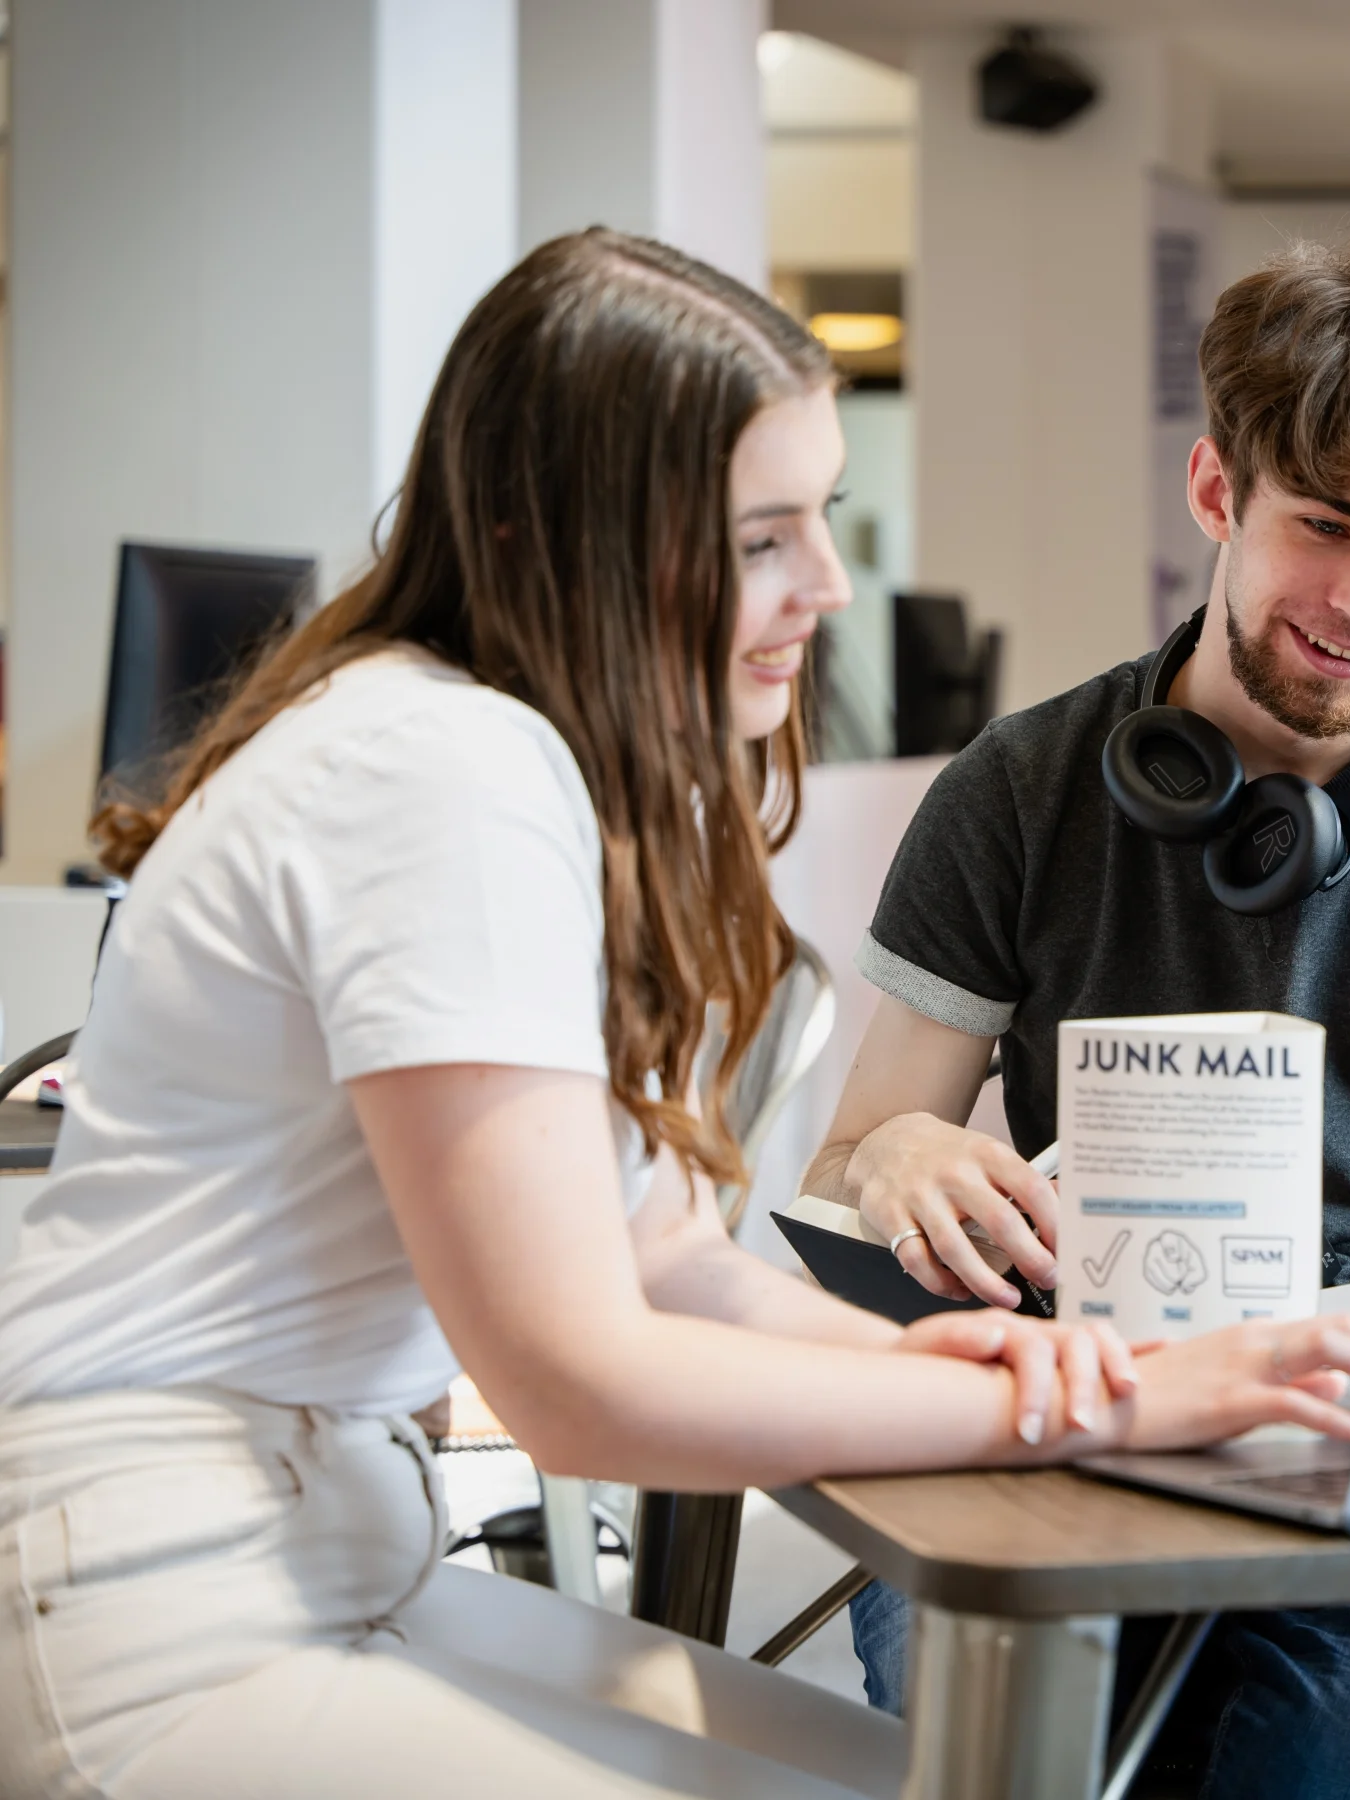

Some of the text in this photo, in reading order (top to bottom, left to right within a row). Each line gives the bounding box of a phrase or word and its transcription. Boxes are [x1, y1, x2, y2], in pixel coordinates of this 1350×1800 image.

[1252, 814, 1297, 874] R
[1075, 1038, 1301, 1079] JUNK MAIL
[1229, 1248, 1284, 1265] SPAM
